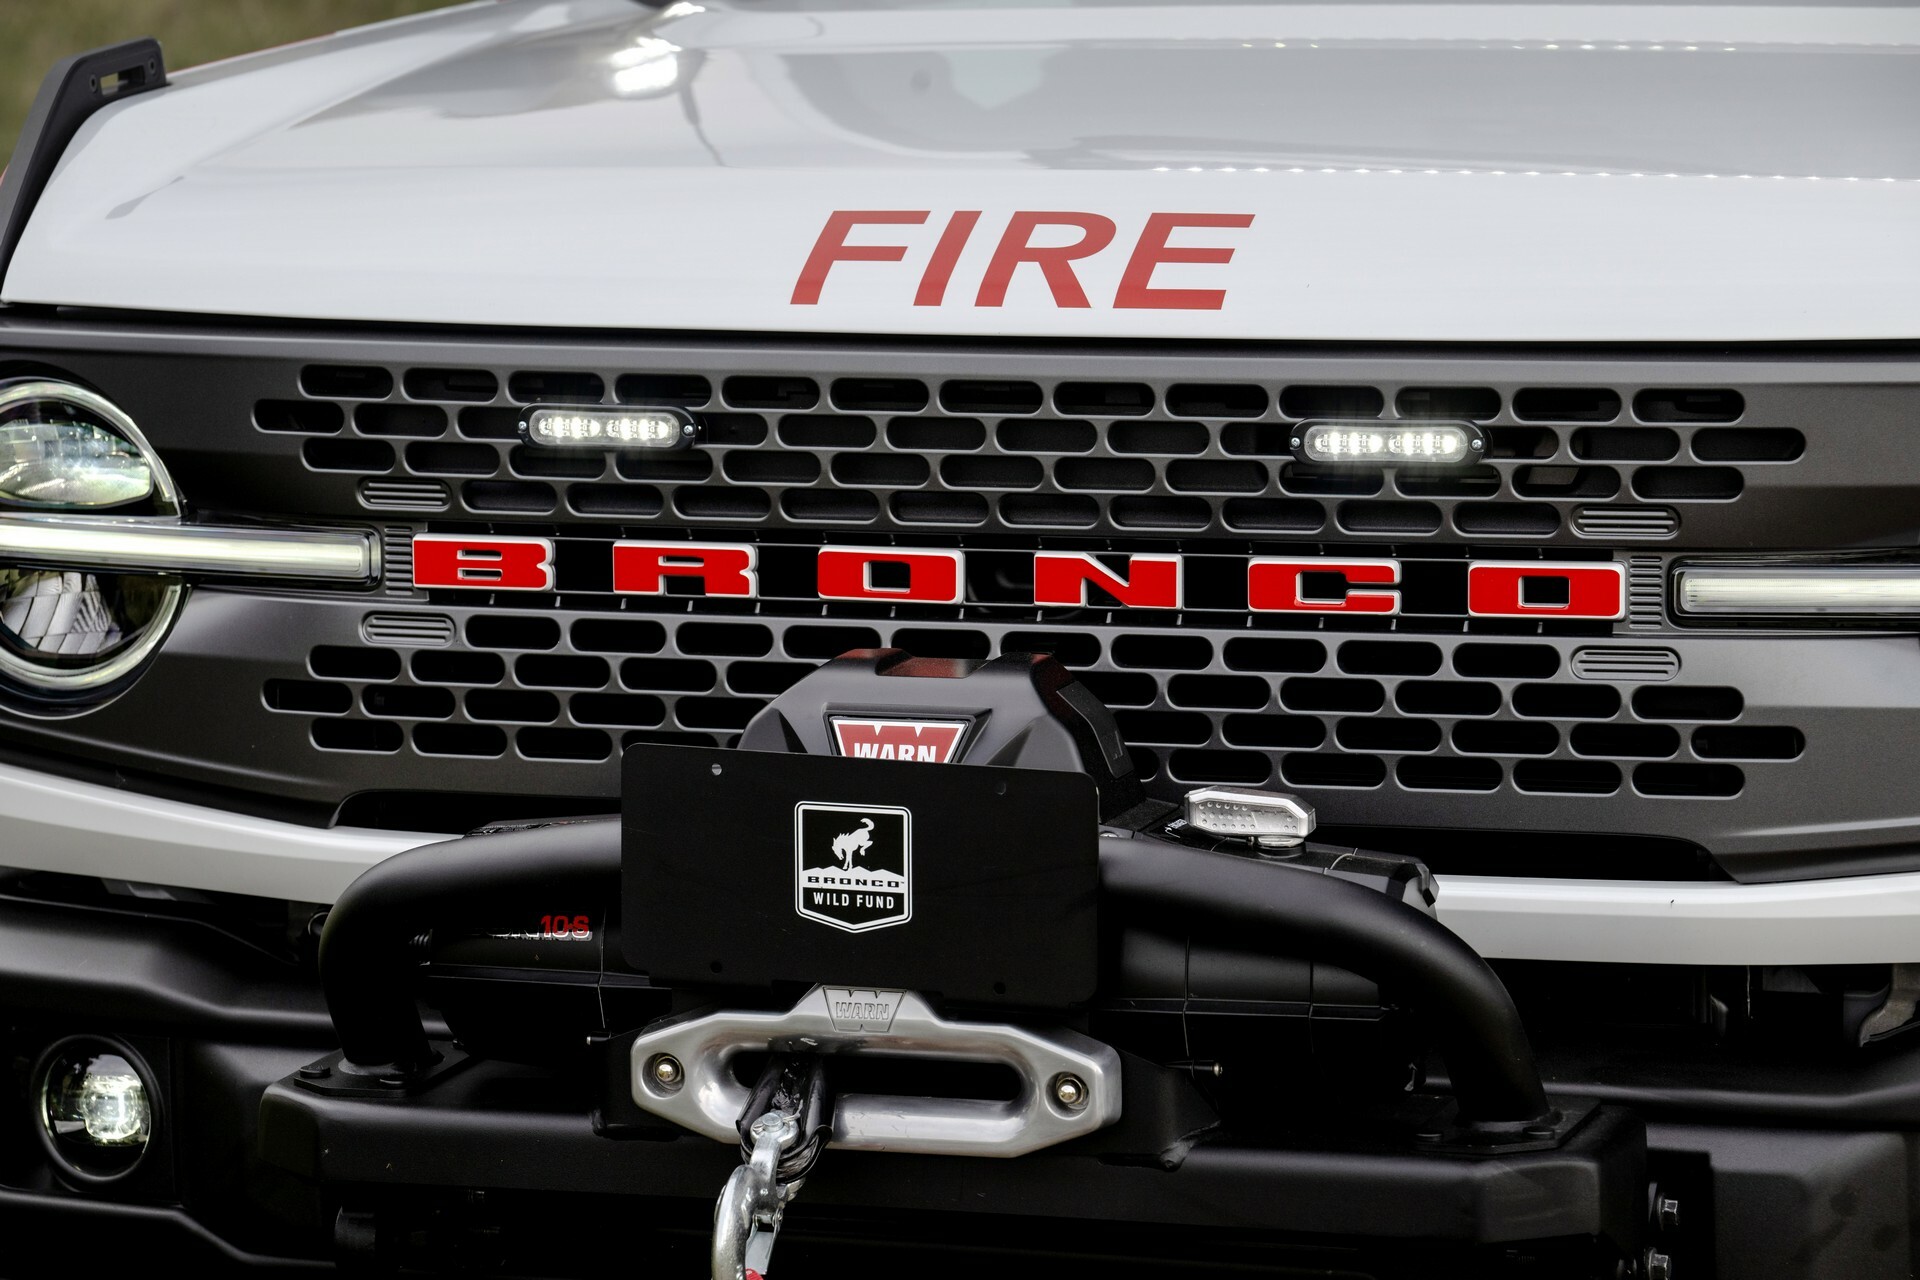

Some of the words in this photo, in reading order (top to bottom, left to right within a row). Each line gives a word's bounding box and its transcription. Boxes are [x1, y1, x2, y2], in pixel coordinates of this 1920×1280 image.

[790, 210, 1256, 310] FIRE
[412, 533, 1628, 620] BRONCO
[854, 742, 937, 763] WARN
[807, 876, 899, 888] BRONCO
[813, 891, 850, 907] WILD
[856, 894, 895, 909] FUND
[835, 1001, 889, 1020] WARN
